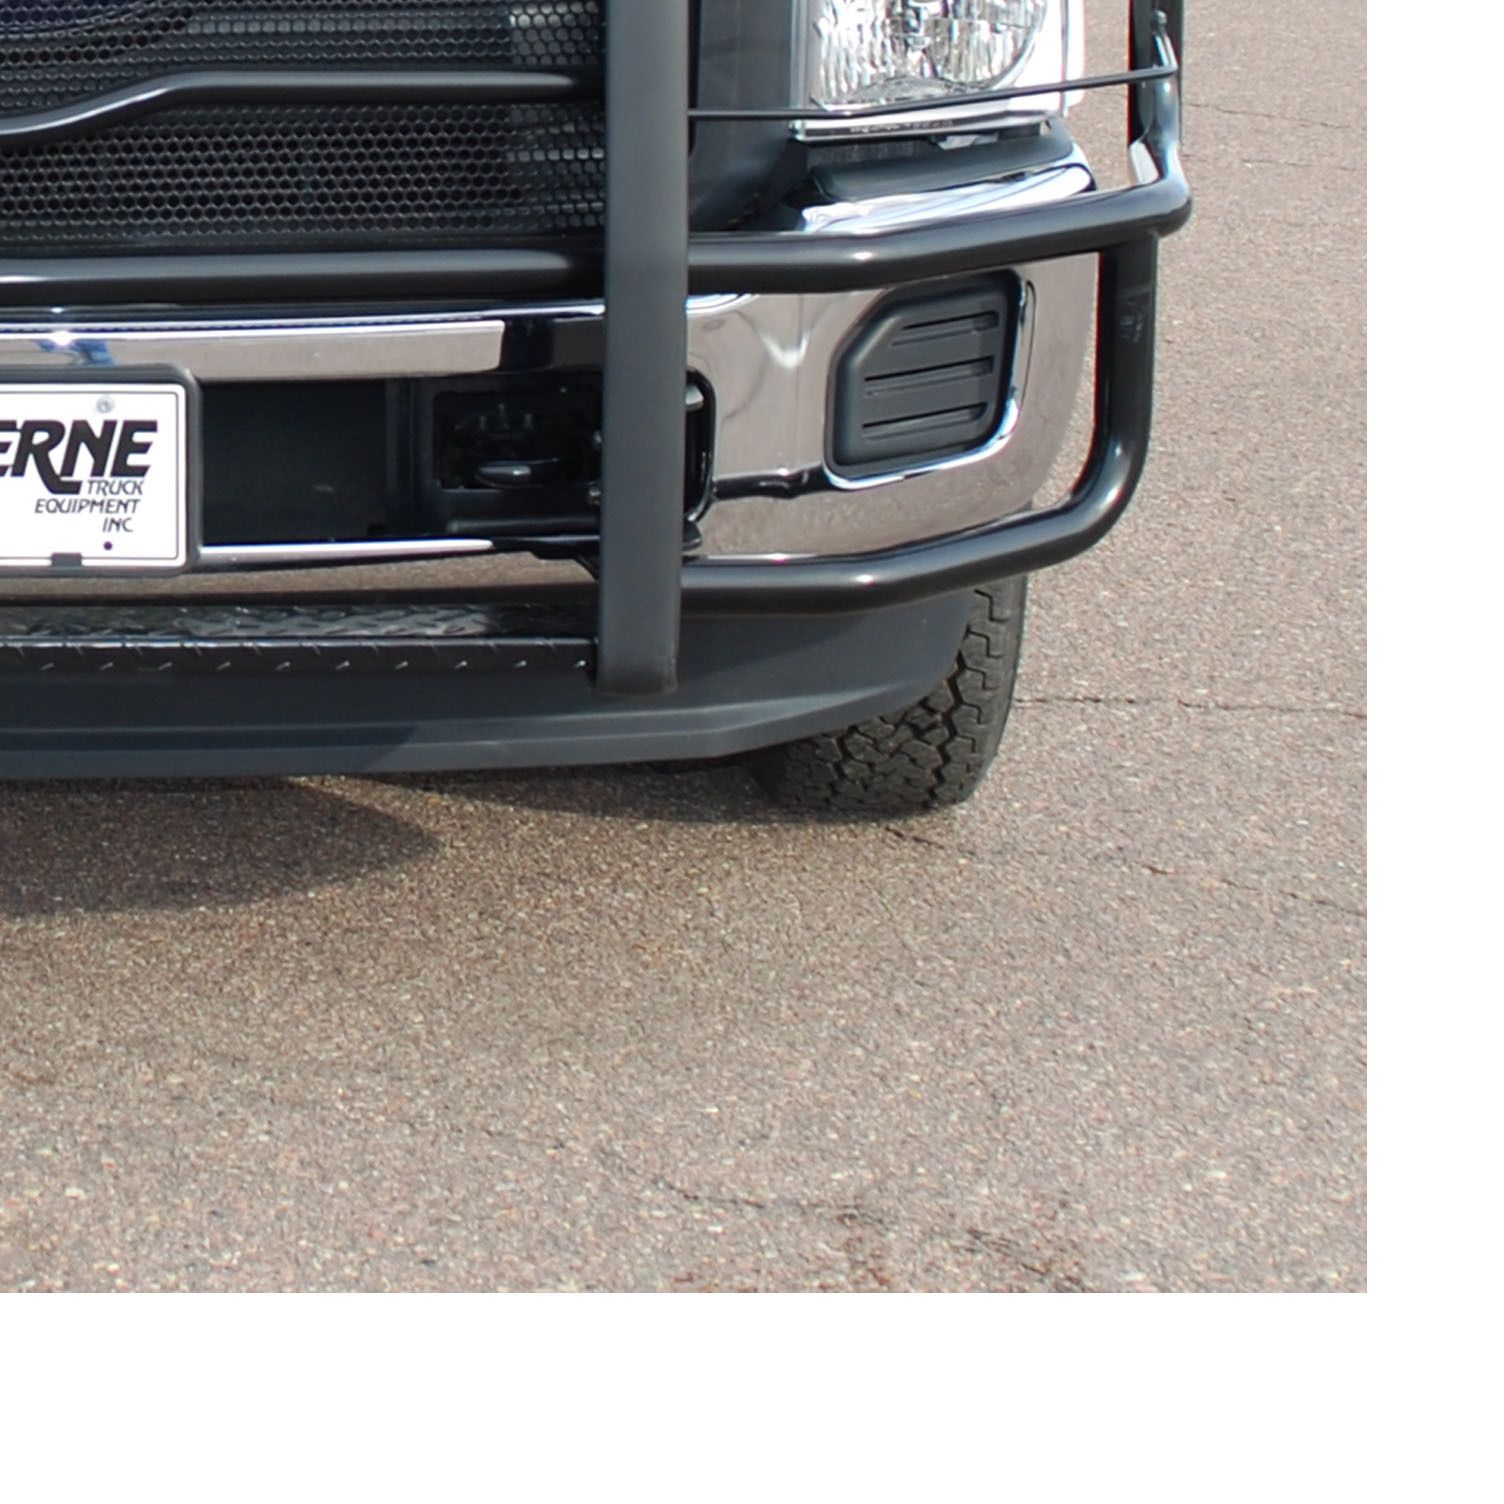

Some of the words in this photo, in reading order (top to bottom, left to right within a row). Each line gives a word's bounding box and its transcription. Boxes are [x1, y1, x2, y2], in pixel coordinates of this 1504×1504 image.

[86, 479, 144, 496] TRUCK
[34, 498, 142, 515] EQUIPMENT
[101, 517, 135, 533] INC
